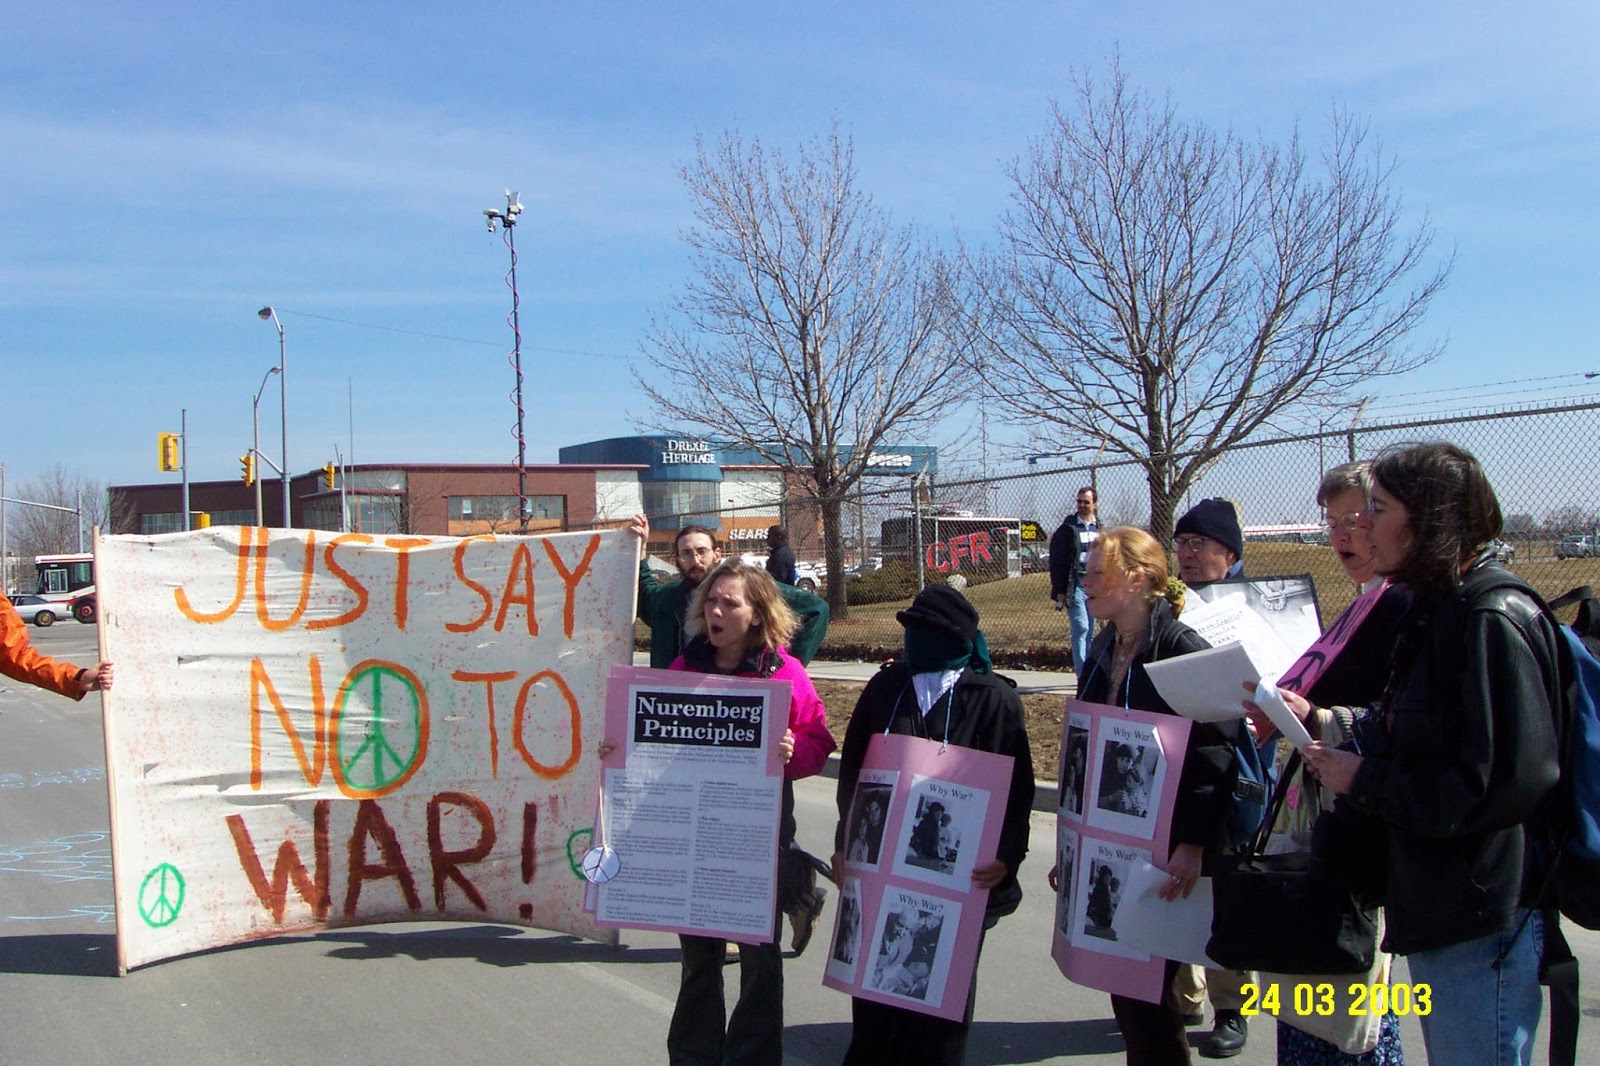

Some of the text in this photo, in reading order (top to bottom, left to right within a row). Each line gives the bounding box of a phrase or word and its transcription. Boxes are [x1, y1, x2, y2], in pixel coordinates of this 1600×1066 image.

[667, 439, 710, 451] DREXEL
[661, 452, 717, 464] HERITAGE
[729, 528, 769, 540] SEARS
[174, 526, 601, 640] JUST SAY
[637, 696, 762, 724] Nuremberg
[249, 652, 582, 800] NO TO
[643, 719, 755, 745] Principles
[1113, 727, 1131, 740] Why
[929, 783, 973, 800] Why War?
[225, 791, 538, 924] WAR!
[1098, 846, 1138, 861] Why War?
[899, 894, 944, 912] Why War?
